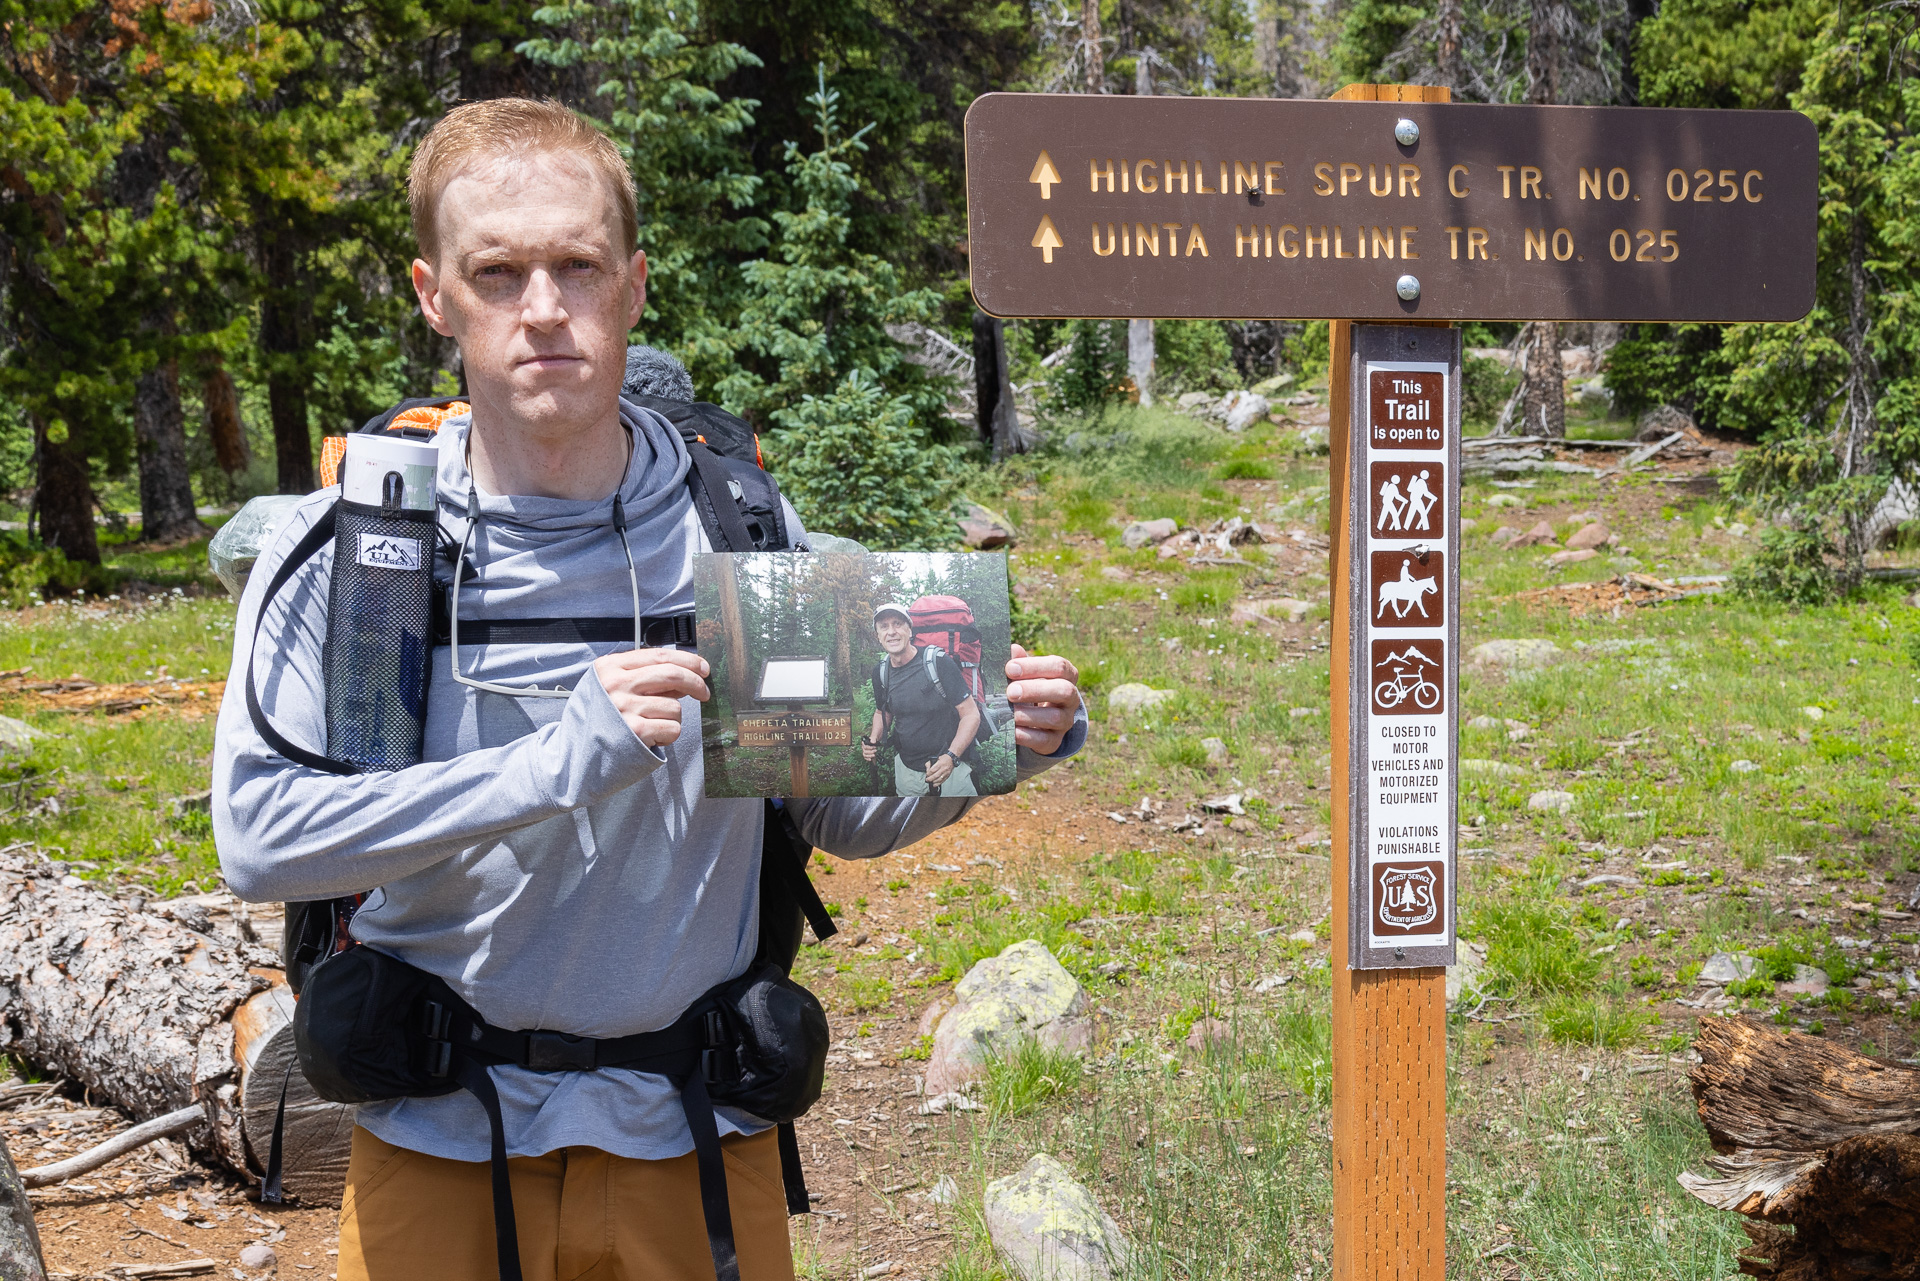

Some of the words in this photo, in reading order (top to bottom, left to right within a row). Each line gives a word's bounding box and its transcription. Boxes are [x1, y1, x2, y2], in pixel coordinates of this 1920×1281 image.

[1090, 158, 1287, 195] HIGHLINE
[1313, 162, 1421, 197] SPUR
[1448, 164, 1470, 198] C
[1497, 165, 1552, 200] TR.
[1579, 167, 1640, 201] NO.
[1666, 168, 1764, 203] 025C
[1091, 222, 1209, 257] UINTA
[1235, 224, 1420, 260] HIGHLINE
[1444, 226, 1500, 261] TR.
[1525, 227, 1585, 262] NO.
[1609, 228, 1680, 263] 025
[1392, 380, 1422, 394] This
[1385, 399, 1430, 421] Trail
[1374, 425, 1387, 439] is
[1389, 427, 1423, 443] open
[1426, 427, 1440, 440] to
[368, 557, 410, 566] EQUIPMENT
[370, 551, 406, 562] ULA
[742, 719, 788, 727] CHEPETA
[792, 718, 846, 727] TRAILHEAD
[744, 732, 785, 740] HIGHLINE
[792, 732, 820, 740] TRAIL
[824, 731, 847, 740] 1025
[1381, 726, 1421, 738] CLOSED
[1423, 725, 1436, 737] TO
[1393, 742, 1428, 754] MOTOR
[1372, 759, 1421, 771] VEHICLES
[1423, 758, 1444, 770] AND
[1380, 775, 1438, 787] MOTORIZED
[1380, 792, 1438, 805] EQUIPMENT
[1379, 826, 1438, 838] VIOLATIONS
[1377, 842, 1440, 855] PUNISHABLE
[1386, 873, 1407, 885] FOREST
[1407, 873, 1430, 884] SERVICE
